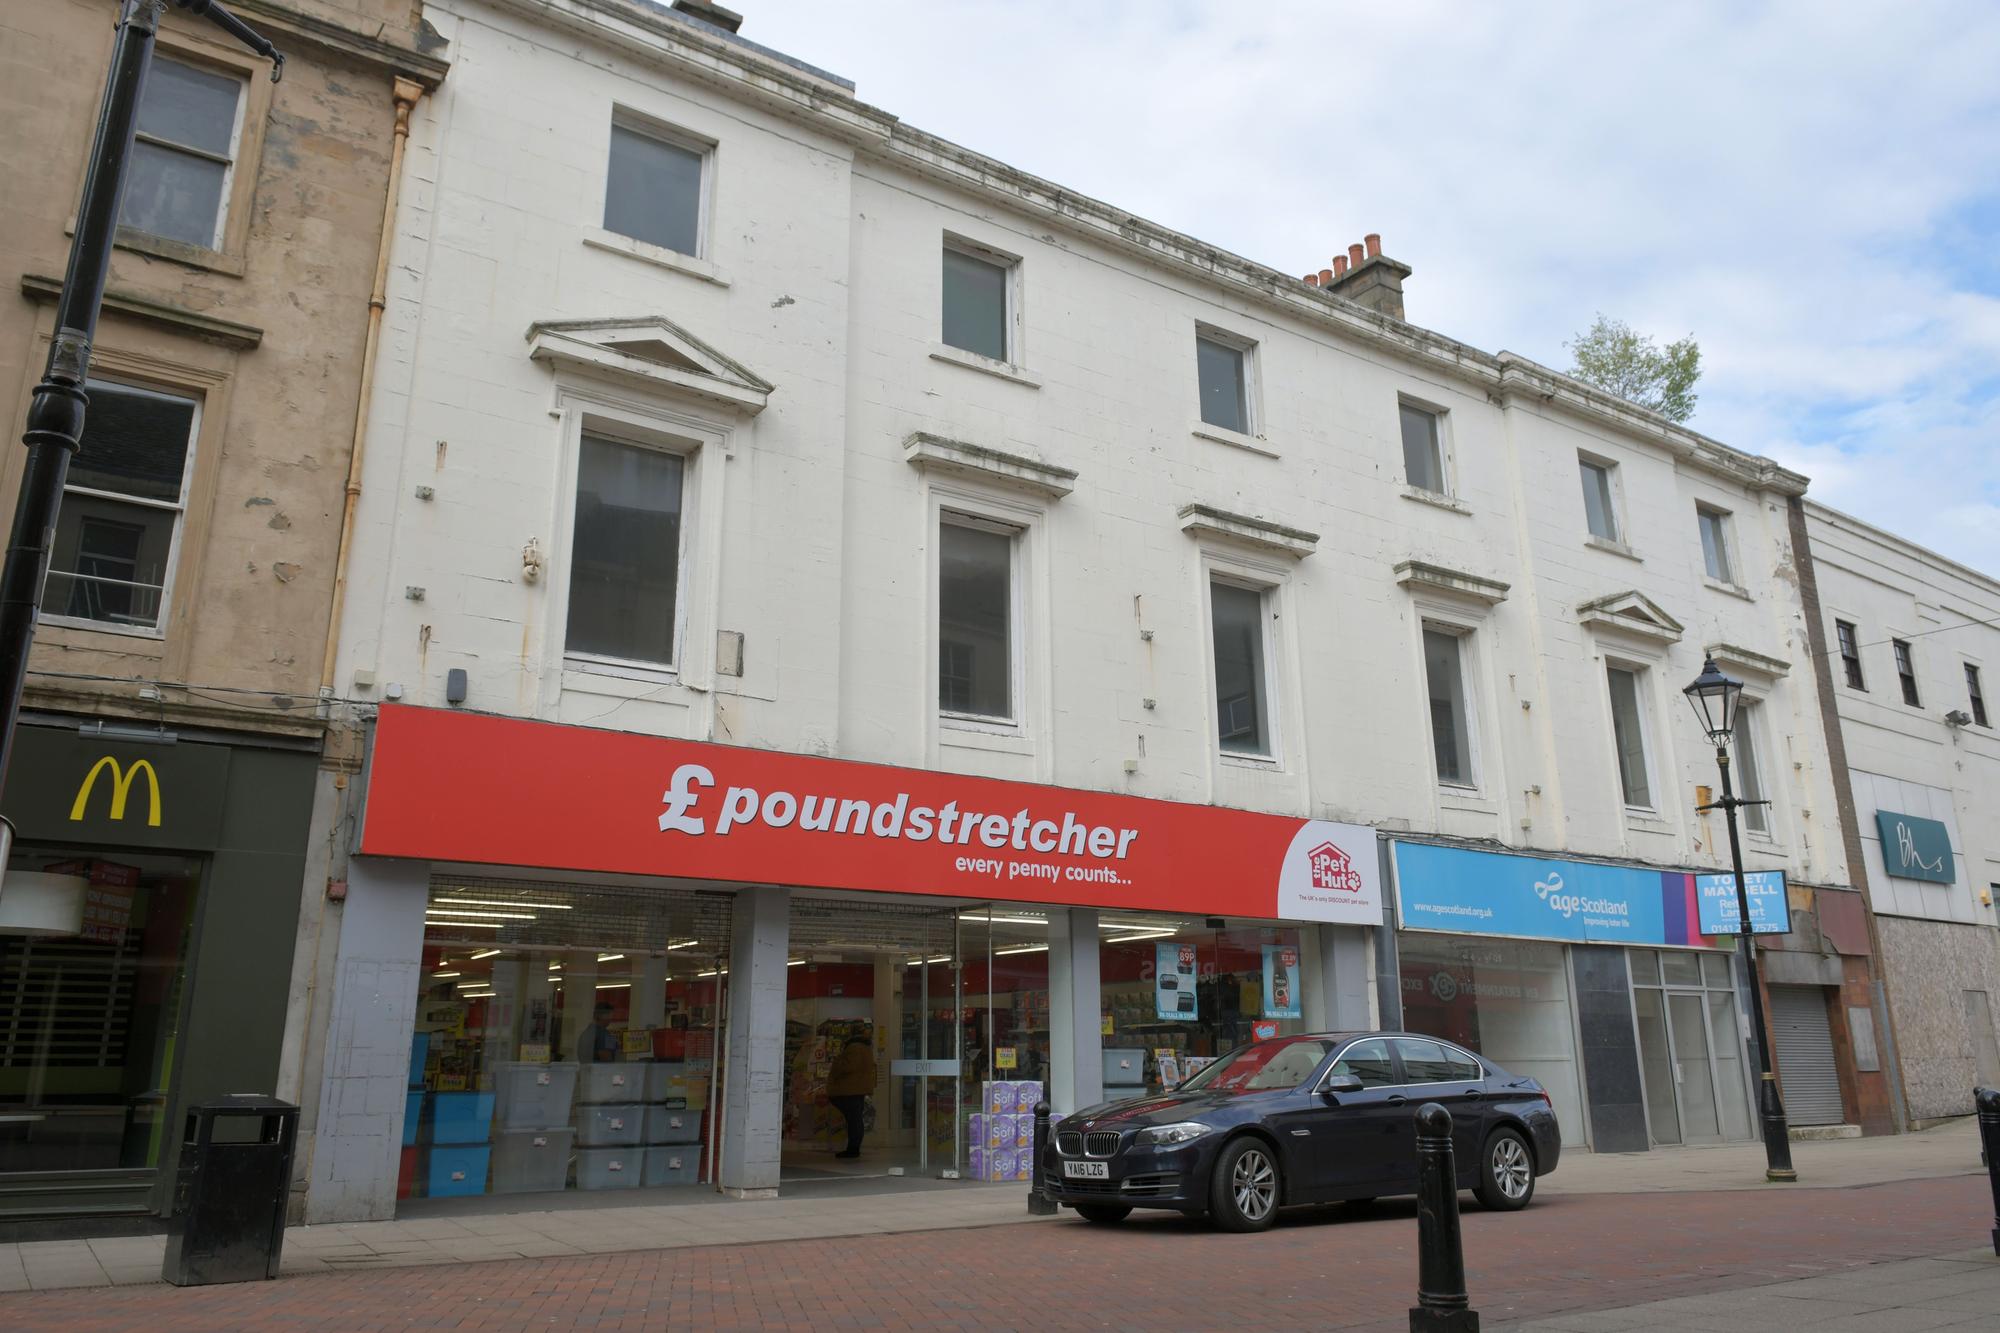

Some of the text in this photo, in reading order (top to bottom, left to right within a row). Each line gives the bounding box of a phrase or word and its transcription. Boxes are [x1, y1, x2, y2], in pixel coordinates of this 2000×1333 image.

[1320, 854, 1347, 873] Pet
[955, 856, 1132, 885] every penny counts...
[1321, 871, 1348, 889] Hut
[1711, 875, 1732, 885] TO
[1704, 886, 1737, 897] MAY
[1328, 896, 1351, 904] DISCOUNT
[1550, 894, 1628, 918] age Scotland
[1413, 903, 1494, 919] www.agescotland.org.uk
[1583, 916, 1609, 928] Improving
[1712, 924, 1733, 933] 0141
[915, 1062, 933, 1073] EXIT
[994, 1092, 1042, 1104] Soft Soft
[993, 1126, 1034, 1138] Soft So
[994, 1159, 1017, 1172] Soft
[1067, 1162, 1104, 1177] YA16 LZG
